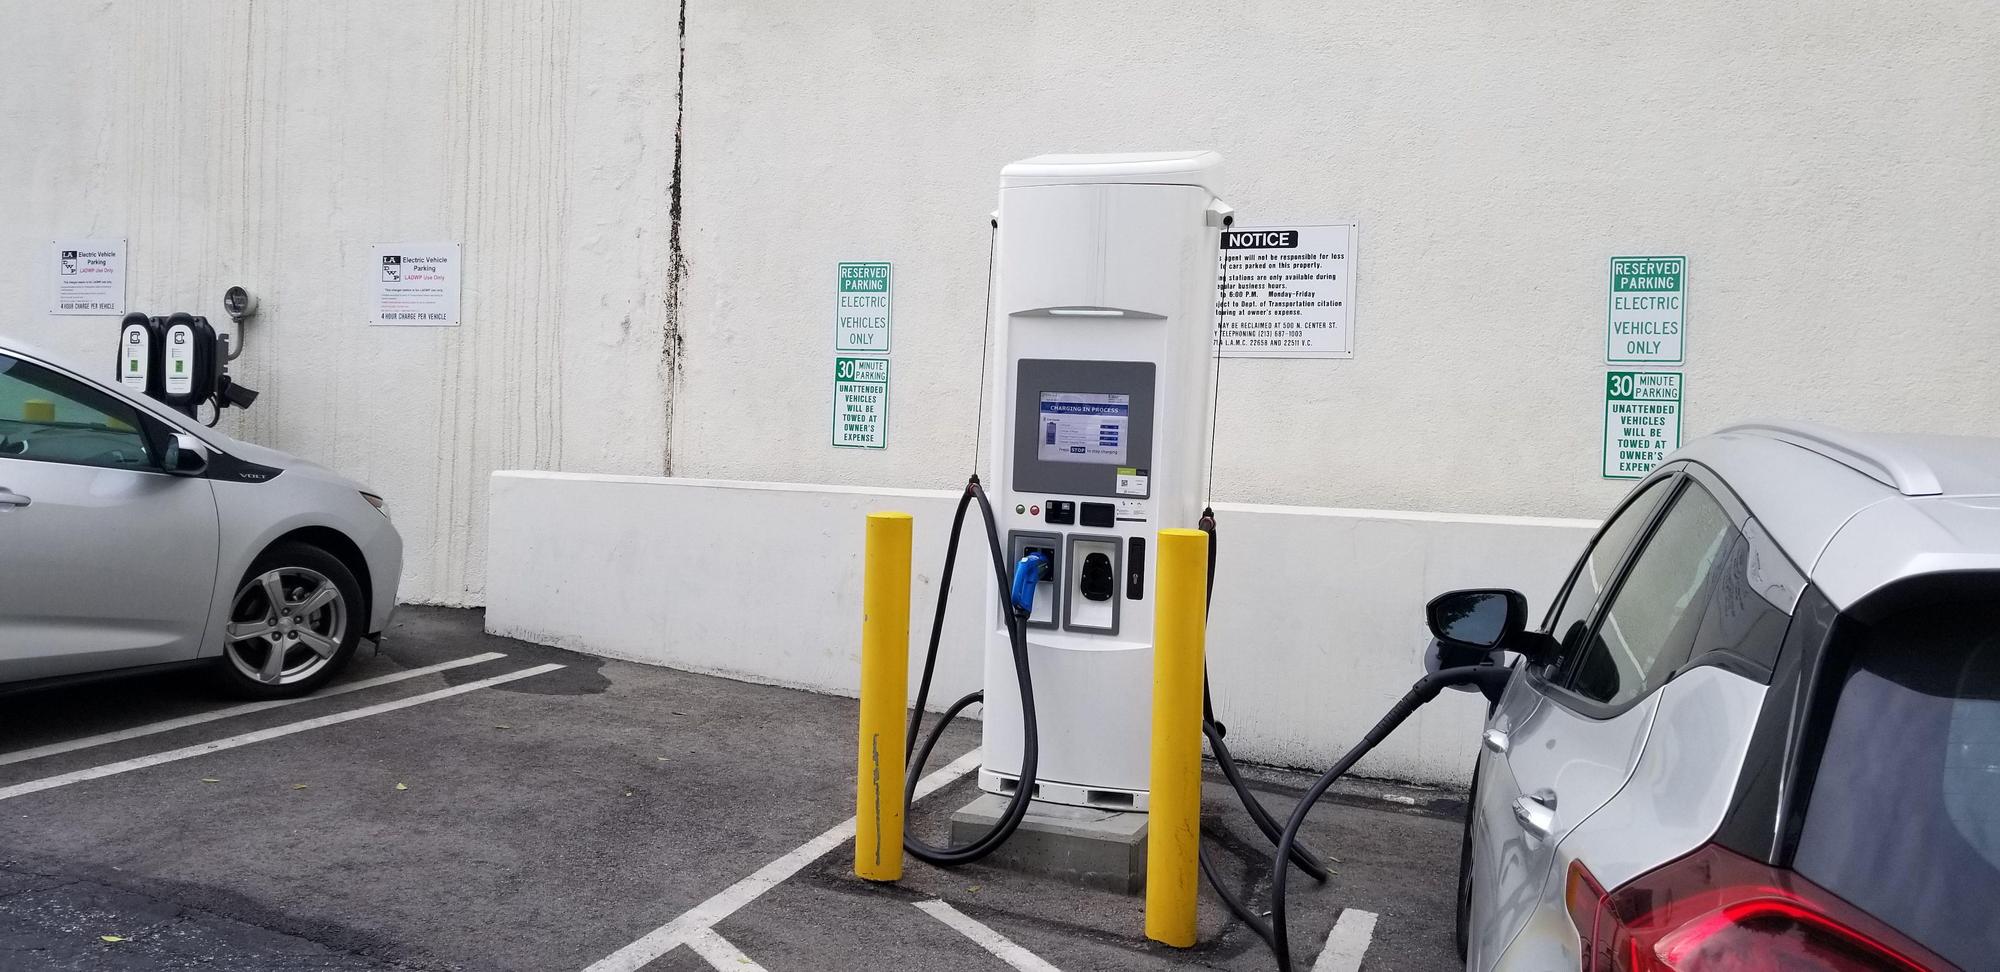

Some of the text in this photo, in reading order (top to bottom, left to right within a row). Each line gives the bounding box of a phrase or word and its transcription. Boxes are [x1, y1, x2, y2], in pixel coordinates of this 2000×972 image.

[1230, 232, 1290, 246] NOTICE
[842, 268, 887, 278] RESERVED
[1616, 263, 1679, 275] RESERVED
[845, 280, 883, 290] PARKING
[1621, 277, 1674, 289] PARKING
[841, 297, 886, 307] ELECTRIC
[1616, 297, 1679, 310] ELECTRIC
[840, 317, 886, 328] VEHICLES
[1614, 322, 1678, 334] VEHICLES
[850, 333, 874, 344] ONLY
[1627, 341, 1661, 354] ONLY
[838, 361, 854, 378] 30
[859, 362, 883, 370] MINUTE
[856, 371, 885, 380] PARKING
[1610, 376, 1632, 396] 30
[1640, 376, 1674, 386] MINUTE
[840, 385, 883, 393] UNATTENDED
[1636, 388, 1677, 398] PARKING
[1613, 405, 1674, 414] UNATTENDED
[1621, 416, 1665, 425] VEHICLES
[844, 424, 874, 432] OWNER'S
[1624, 428, 1661, 437] WILL BE
[844, 434, 874, 442] EXPENSE
[1618, 439, 1667, 449] TOWED AT
[1620, 451, 1663, 460] OWNER'S
